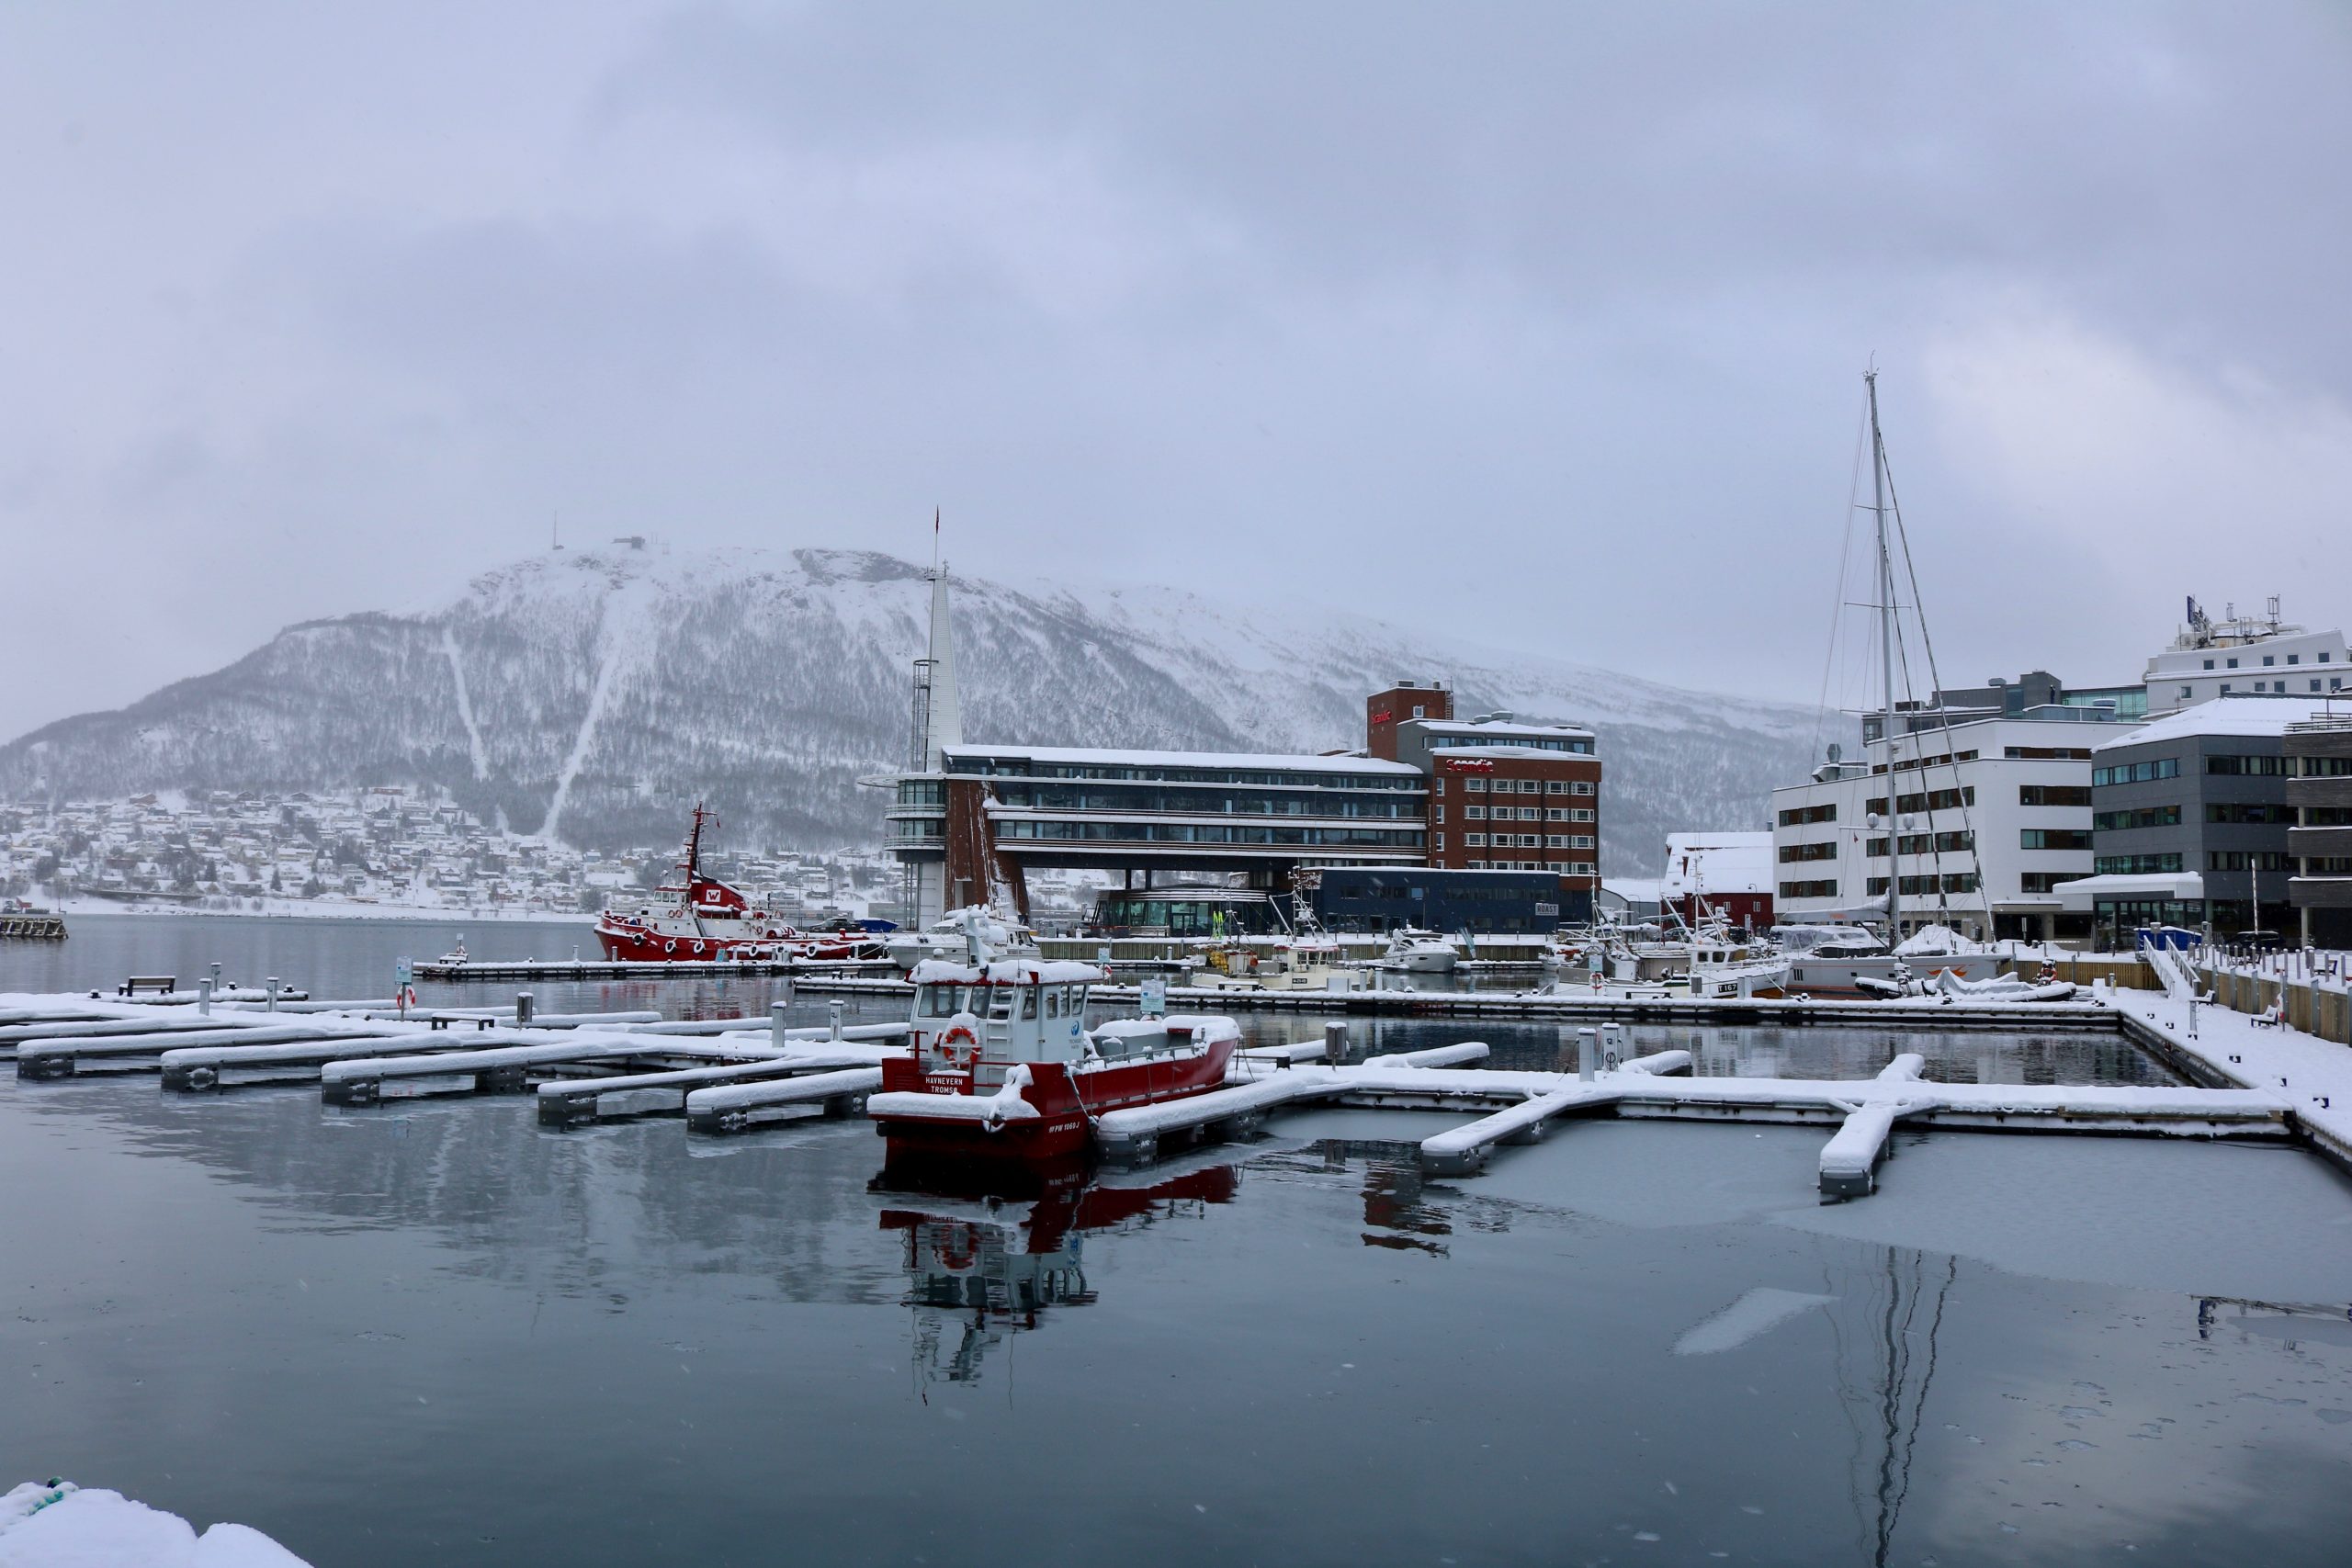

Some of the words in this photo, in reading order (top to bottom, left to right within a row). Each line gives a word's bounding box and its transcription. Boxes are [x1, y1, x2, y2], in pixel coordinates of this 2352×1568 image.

[1446, 759, 1493, 772] Scandic
[1537, 905, 1557, 913] ROAST
[925, 1077, 963, 1086] HAVNEVERN
